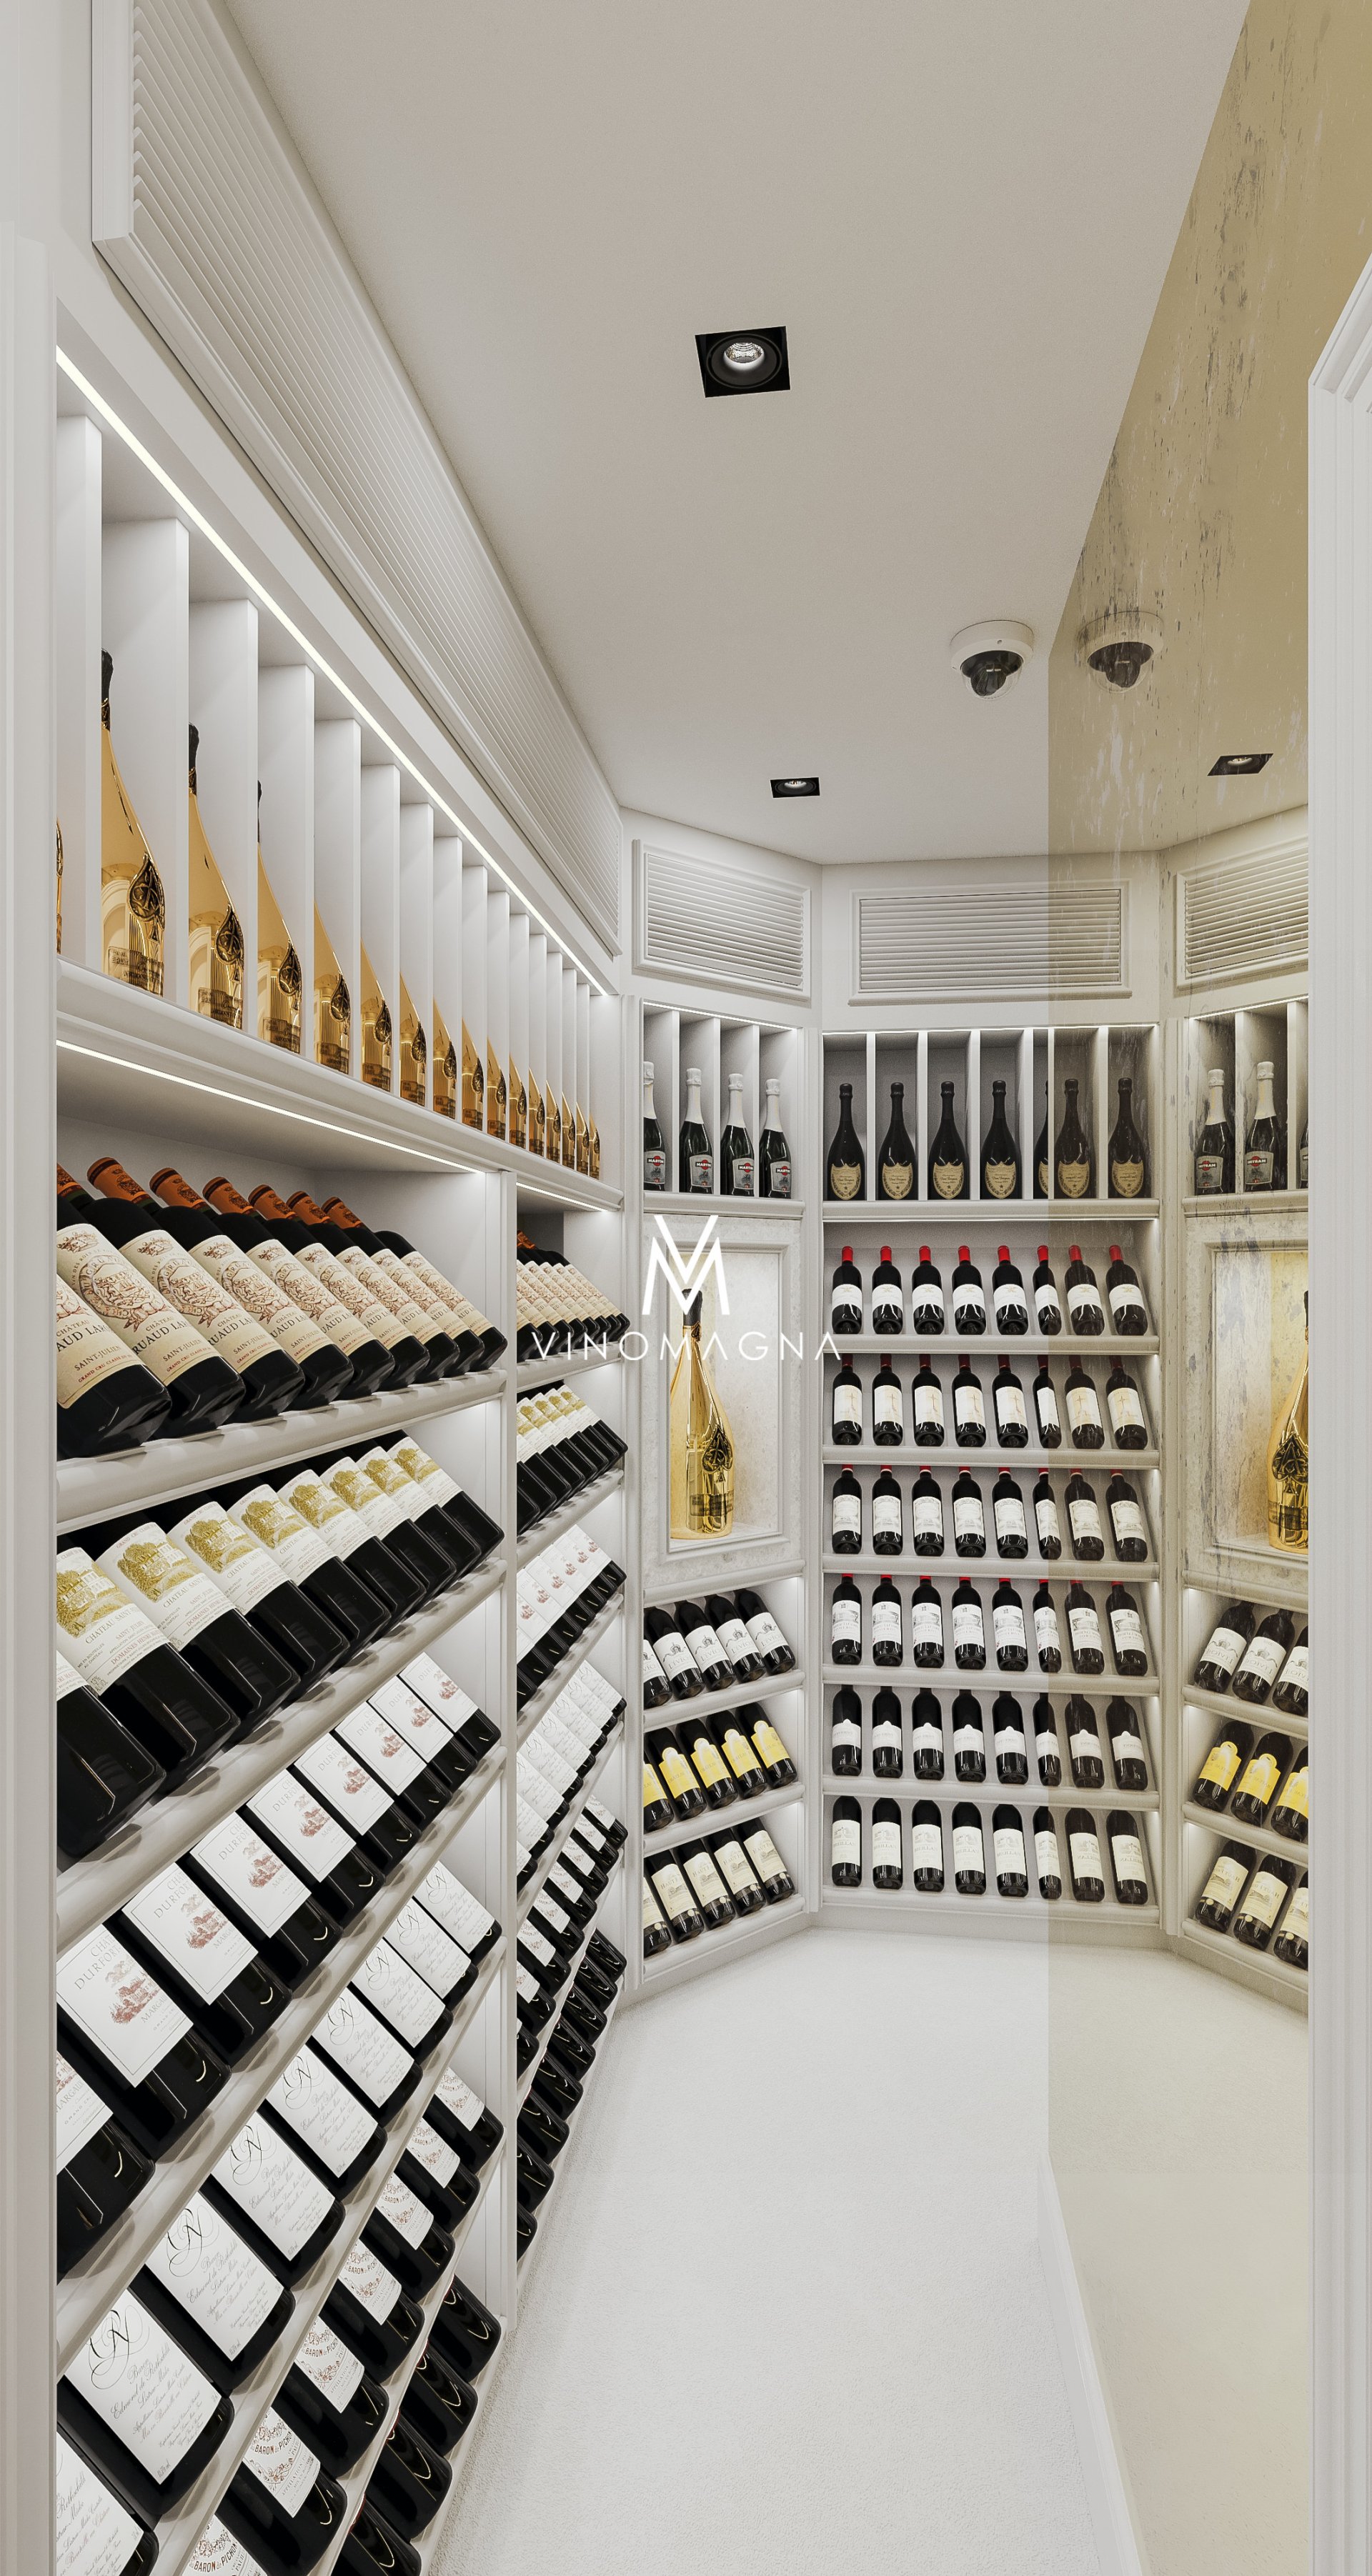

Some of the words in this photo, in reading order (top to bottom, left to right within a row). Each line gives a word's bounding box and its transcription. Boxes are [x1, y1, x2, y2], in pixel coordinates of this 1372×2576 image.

[304, 2347, 323, 2357] BARON
[254, 2444, 275, 2455] BARON
[194, 2560, 216, 2572] BARON
